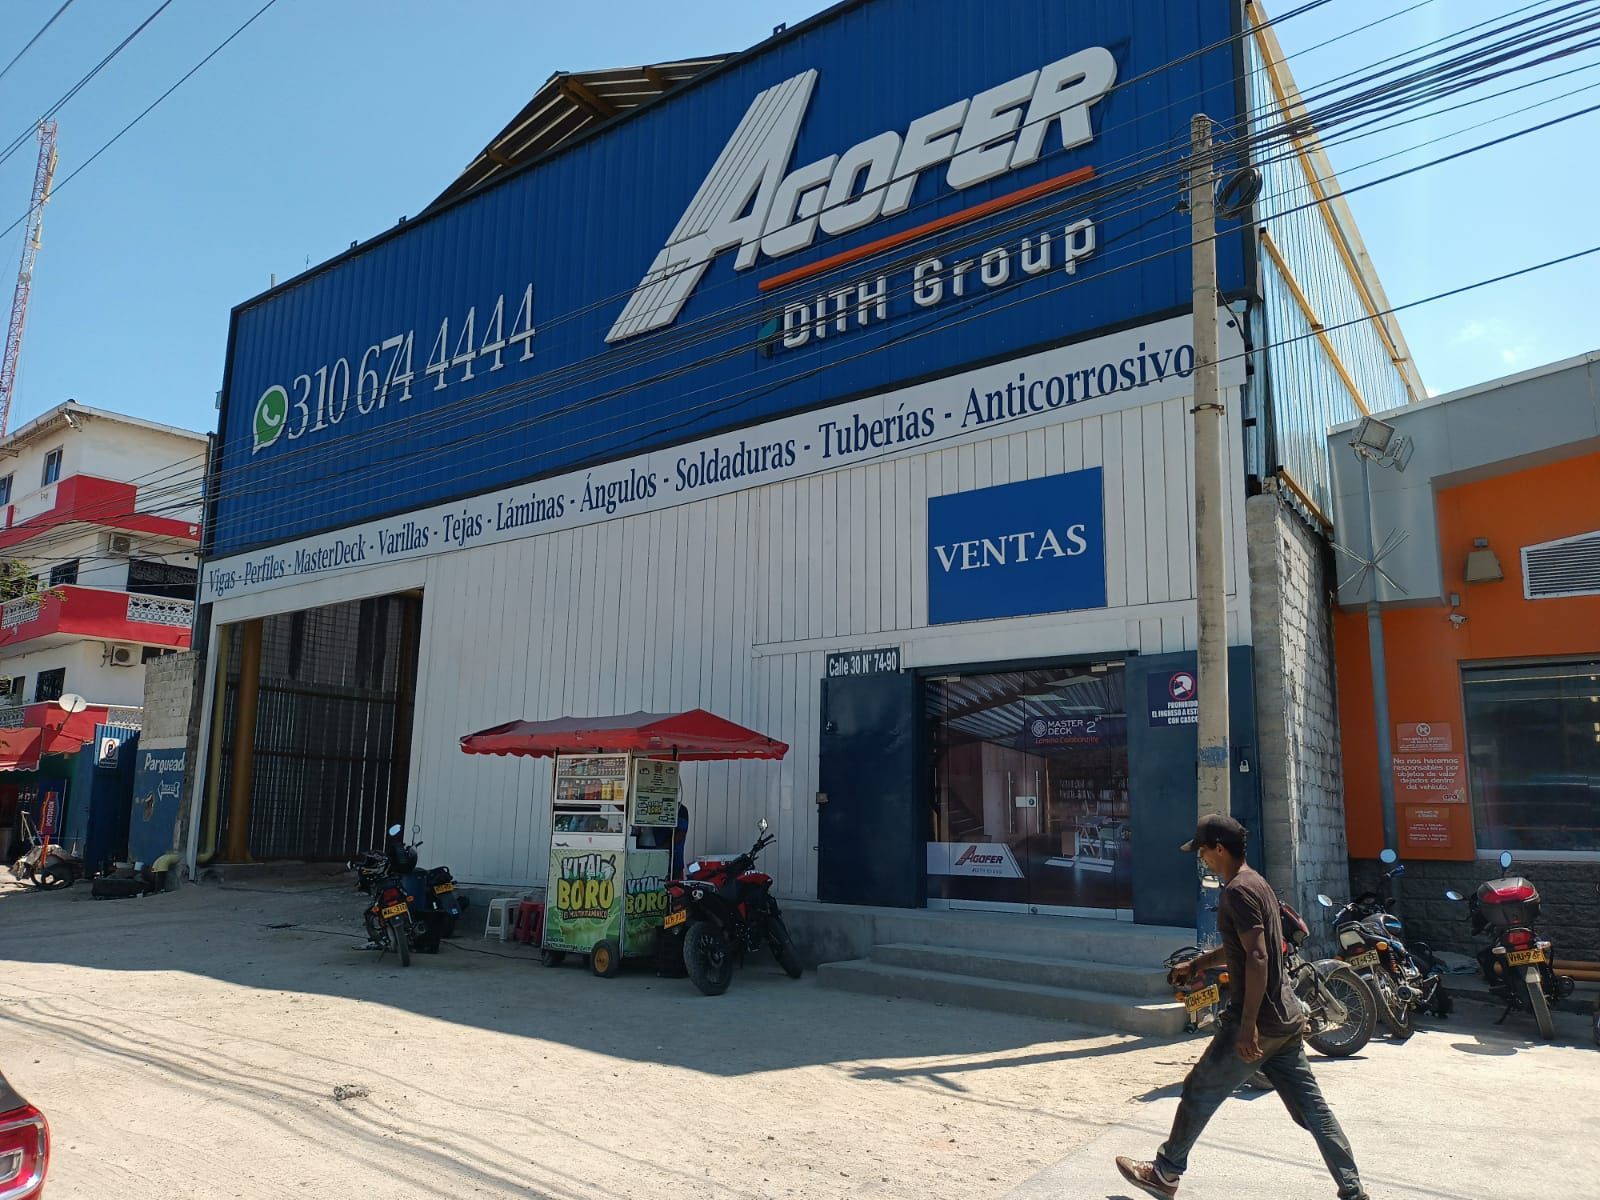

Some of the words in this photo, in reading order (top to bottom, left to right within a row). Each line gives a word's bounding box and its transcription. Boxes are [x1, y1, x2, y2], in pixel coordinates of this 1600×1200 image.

[604, 46, 1118, 343] AGOFER
[783, 275, 887, 349] DITH
[914, 218, 1097, 308] Group
[288, 357, 350, 441] 310
[357, 329, 415, 415] 674
[425, 282, 536, 392] 4444
[209, 569, 236, 597] Vigas
[244, 555, 285, 586] Perfiles
[294, 534, 366, 575] MasterDeck
[378, 521, 429, 557] Varillas
[442, 509, 483, 547] Tejas
[495, 492, 565, 532] Láminas
[579, 469, 657, 515] Ángulos
[675, 439, 796, 492] Soldaduras
[818, 402, 935, 460] Tuberías
[960, 342, 1195, 429] Anticorrosivo
[934, 523, 1088, 573] VENTAS
[829, 656, 849, 677] Calle
[850, 655, 860, 674] 30
[874, 651, 897, 672] 74-90
[1158, 709, 1182, 718] INGRESO
[1168, 700, 1198, 709] PROHIBIDO
[1047, 719, 1084, 728] MASTER
[1047, 727, 1073, 736] DECK
[1168, 717, 1180, 725] CON
[144, 751, 186, 774] Parquead
[954, 845, 1004, 866] AGOFER
[558, 878, 614, 911] BORO
[626, 892, 667, 914] BORO
